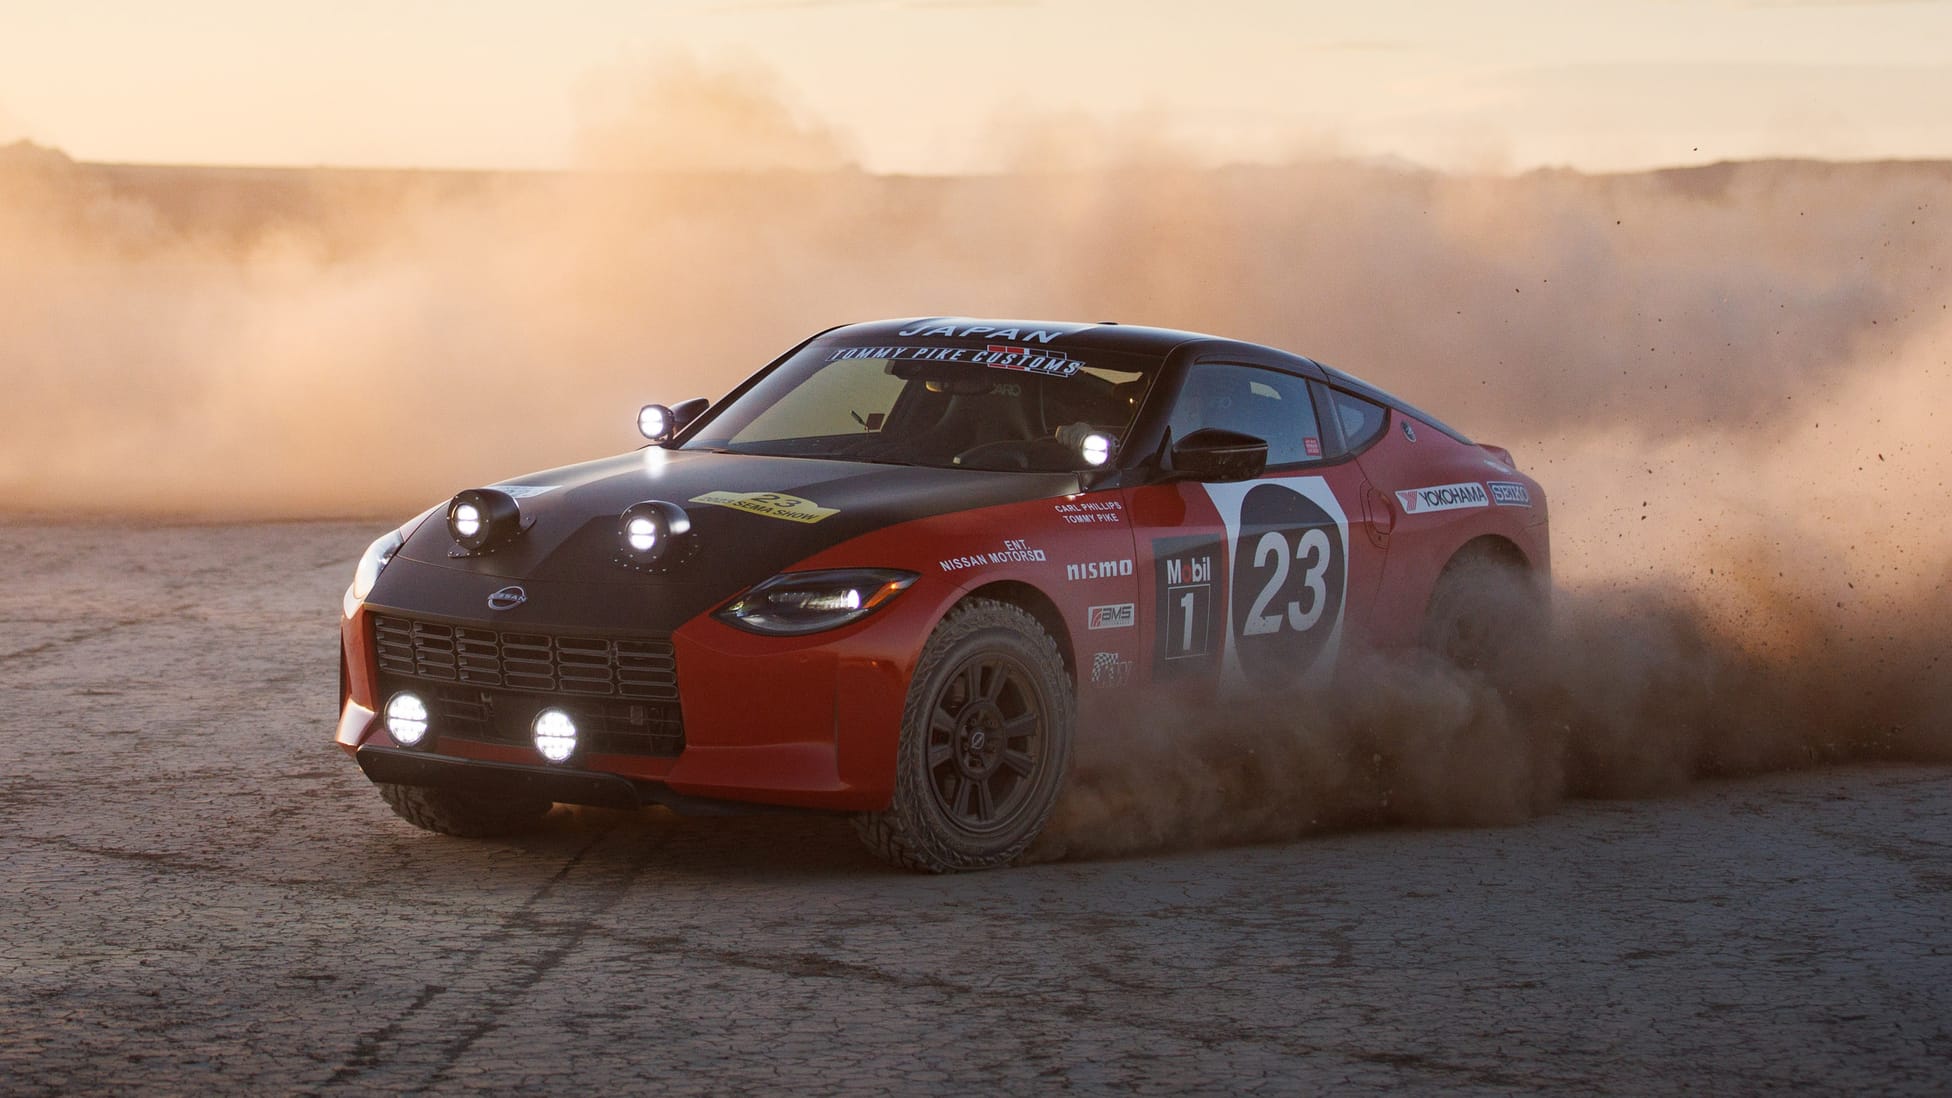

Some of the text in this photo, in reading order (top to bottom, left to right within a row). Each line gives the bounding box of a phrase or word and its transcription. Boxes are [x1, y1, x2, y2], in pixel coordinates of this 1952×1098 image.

[899, 326, 1064, 343] JAPAN
[831, 347, 1081, 374] TOMMY PIKE CUSTOMS
[750, 494, 802, 507] 23
[1418, 486, 1487, 507] YOKOHAMA
[1492, 485, 1529, 503] SEIKO
[733, 501, 773, 513] SEMA
[772, 509, 820, 520] SHOW
[1055, 501, 1122, 513] CARL PHILLIPS
[1063, 513, 1119, 524] TOMMY PIKE
[939, 550, 1036, 572] NISSAN MOTORS
[1166, 556, 1211, 585] Mobil
[1243, 529, 1331, 636] 23
[1180, 592, 1195, 651] 1
